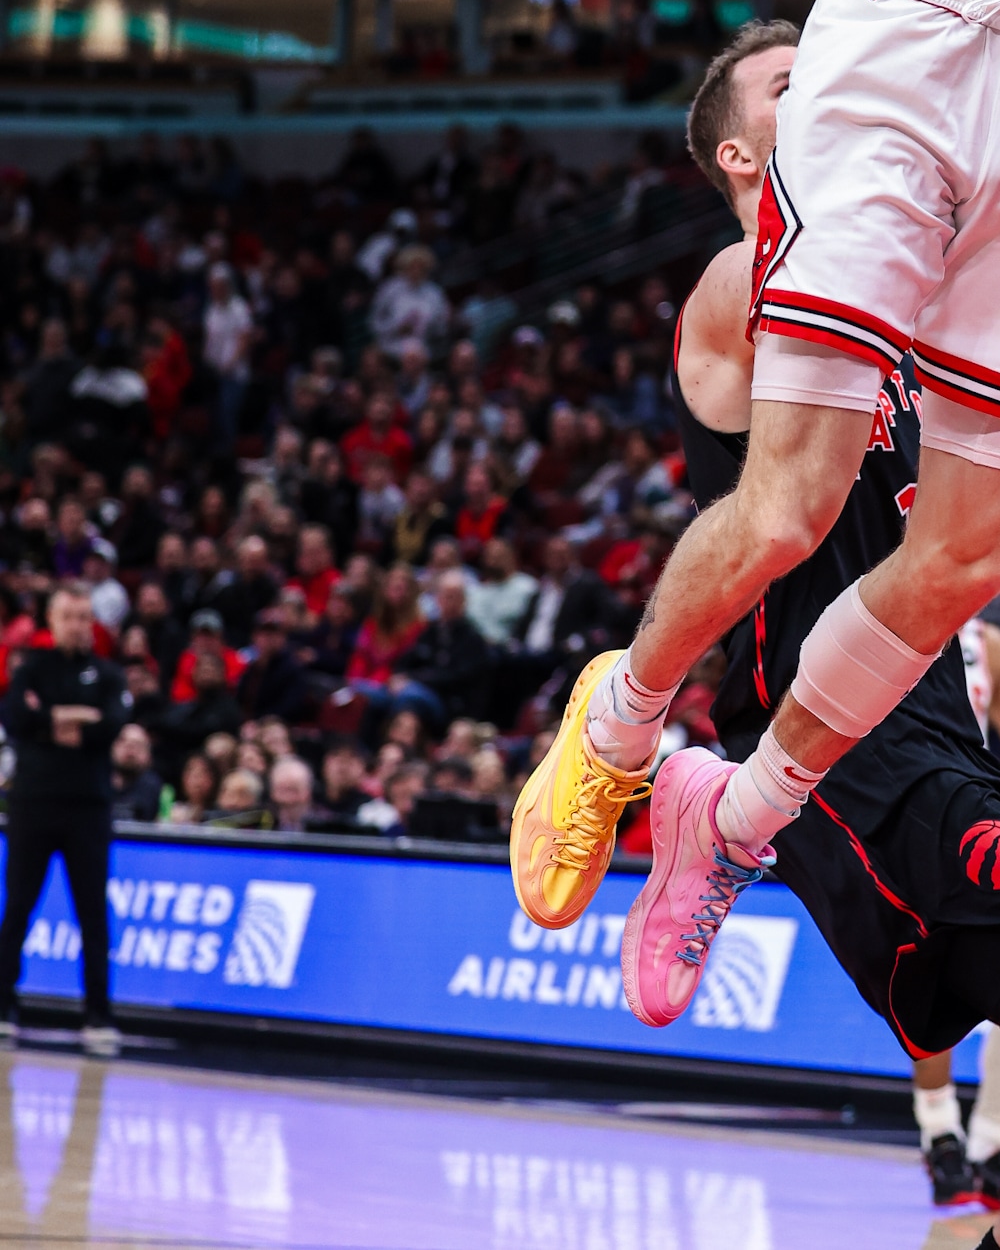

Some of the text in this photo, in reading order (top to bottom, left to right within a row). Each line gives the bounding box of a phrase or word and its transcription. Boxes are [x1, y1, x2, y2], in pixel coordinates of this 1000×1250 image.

[106, 878, 234, 927] NITED
[508, 906, 627, 958] UNIT
[447, 954, 634, 1013] AIRLIN
